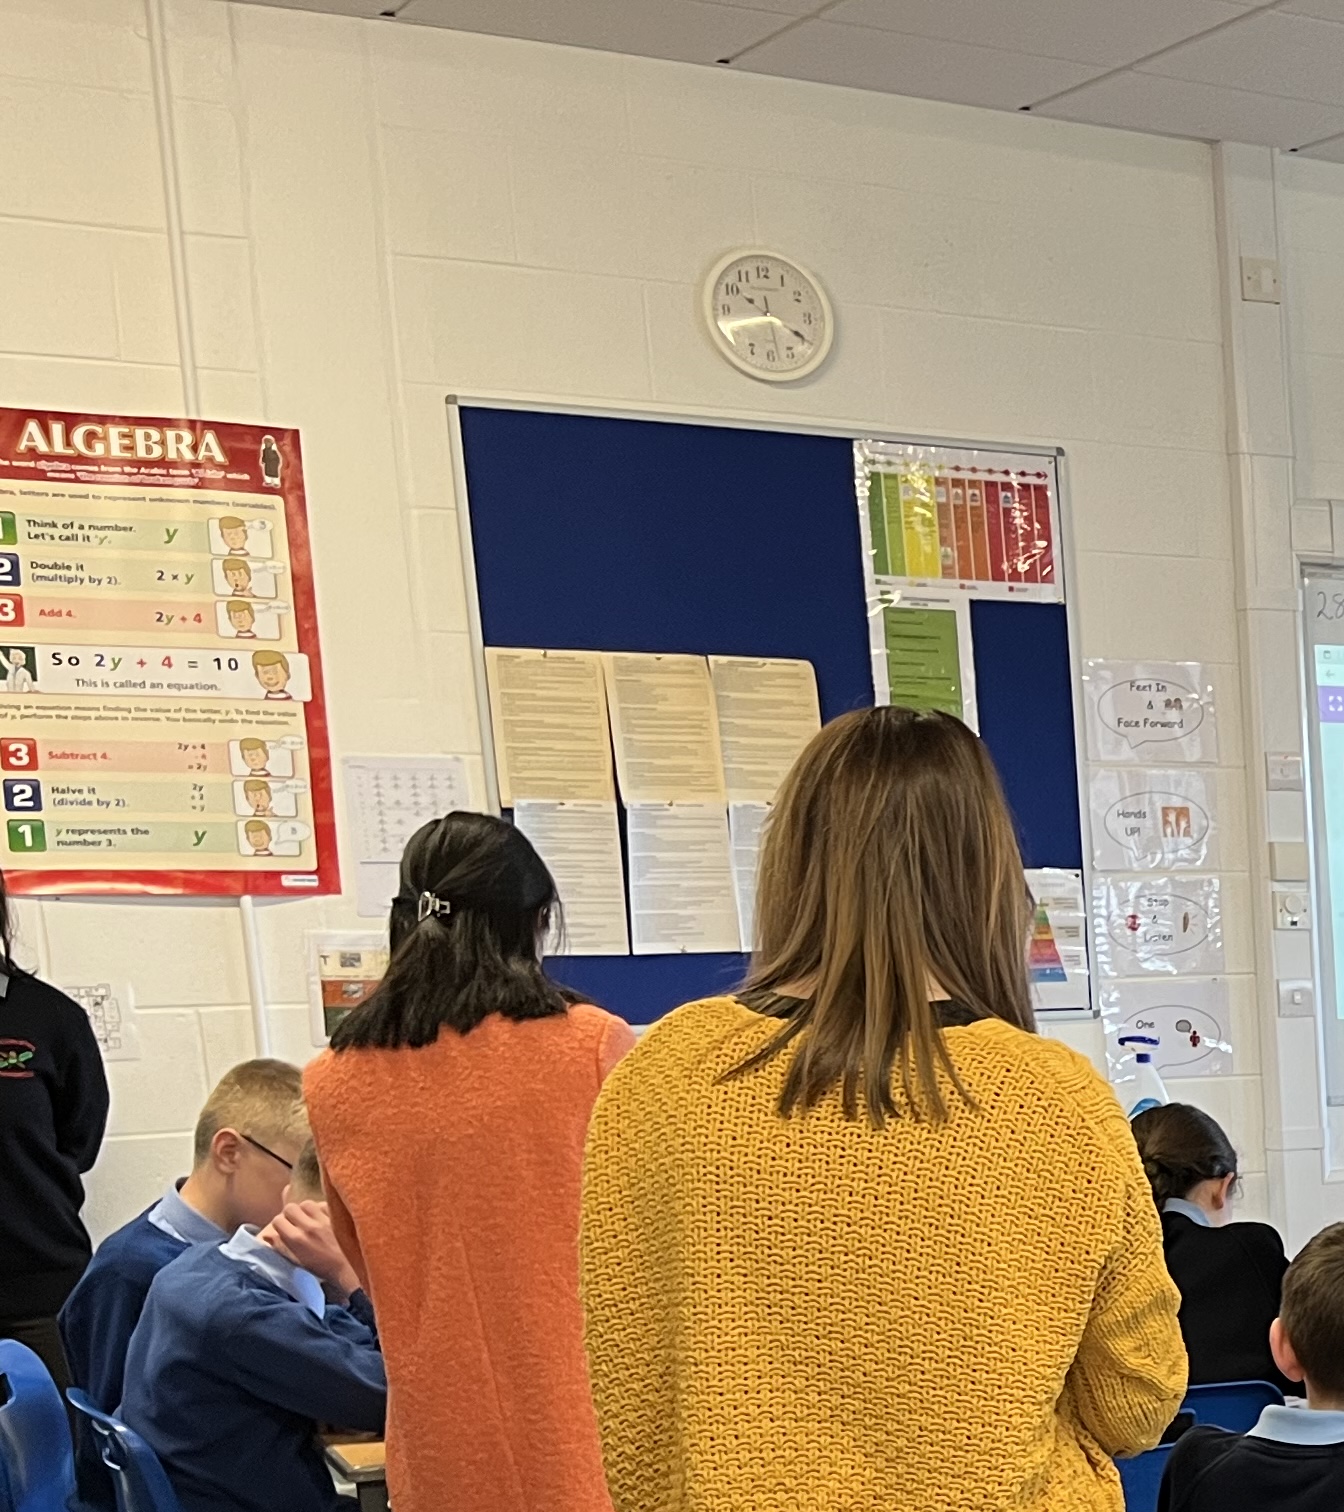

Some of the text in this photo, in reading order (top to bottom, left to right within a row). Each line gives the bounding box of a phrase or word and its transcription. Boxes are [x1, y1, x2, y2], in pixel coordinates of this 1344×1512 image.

[755, 265, 770, 279] 12
[725, 282, 740, 296] 10
[17, 419, 229, 465] ALGEBRA
[26, 519, 137, 533] Think of a number.
[58, 532, 79, 542] call
[81, 533, 91, 543] it
[163, 527, 180, 544] y
[30, 560, 84, 572] Double it
[31, 572, 85, 586] (multiply
[88, 575, 101, 586] by
[156, 570, 166, 581] 2
[184, 572, 195, 585] y
[38, 608, 63, 618] Add
[155, 611, 175, 626] 2y
[193, 612, 203, 624] 4
[51, 652, 81, 667] So
[161, 655, 173, 669] 4
[213, 657, 240, 672] 10
[75, 678, 221, 694] This is called an equation.
[1129, 681, 1167, 693] Feet In
[1117, 717, 1184, 728] Face Forward
[8, 742, 30, 766] 3
[48, 751, 98, 761] Subtract
[12, 784, 35, 807] 2
[51, 786, 96, 796] Halve it
[52, 797, 93, 809] (divide
[96, 798, 111, 809] by
[1116, 809, 1147, 820] Hands
[17, 825, 34, 847] 1
[65, 828, 128, 840] represents
[131, 828, 150, 837] the
[193, 830, 208, 847] y
[56, 838, 102, 848] number
[1136, 1020, 1155, 1030] One
